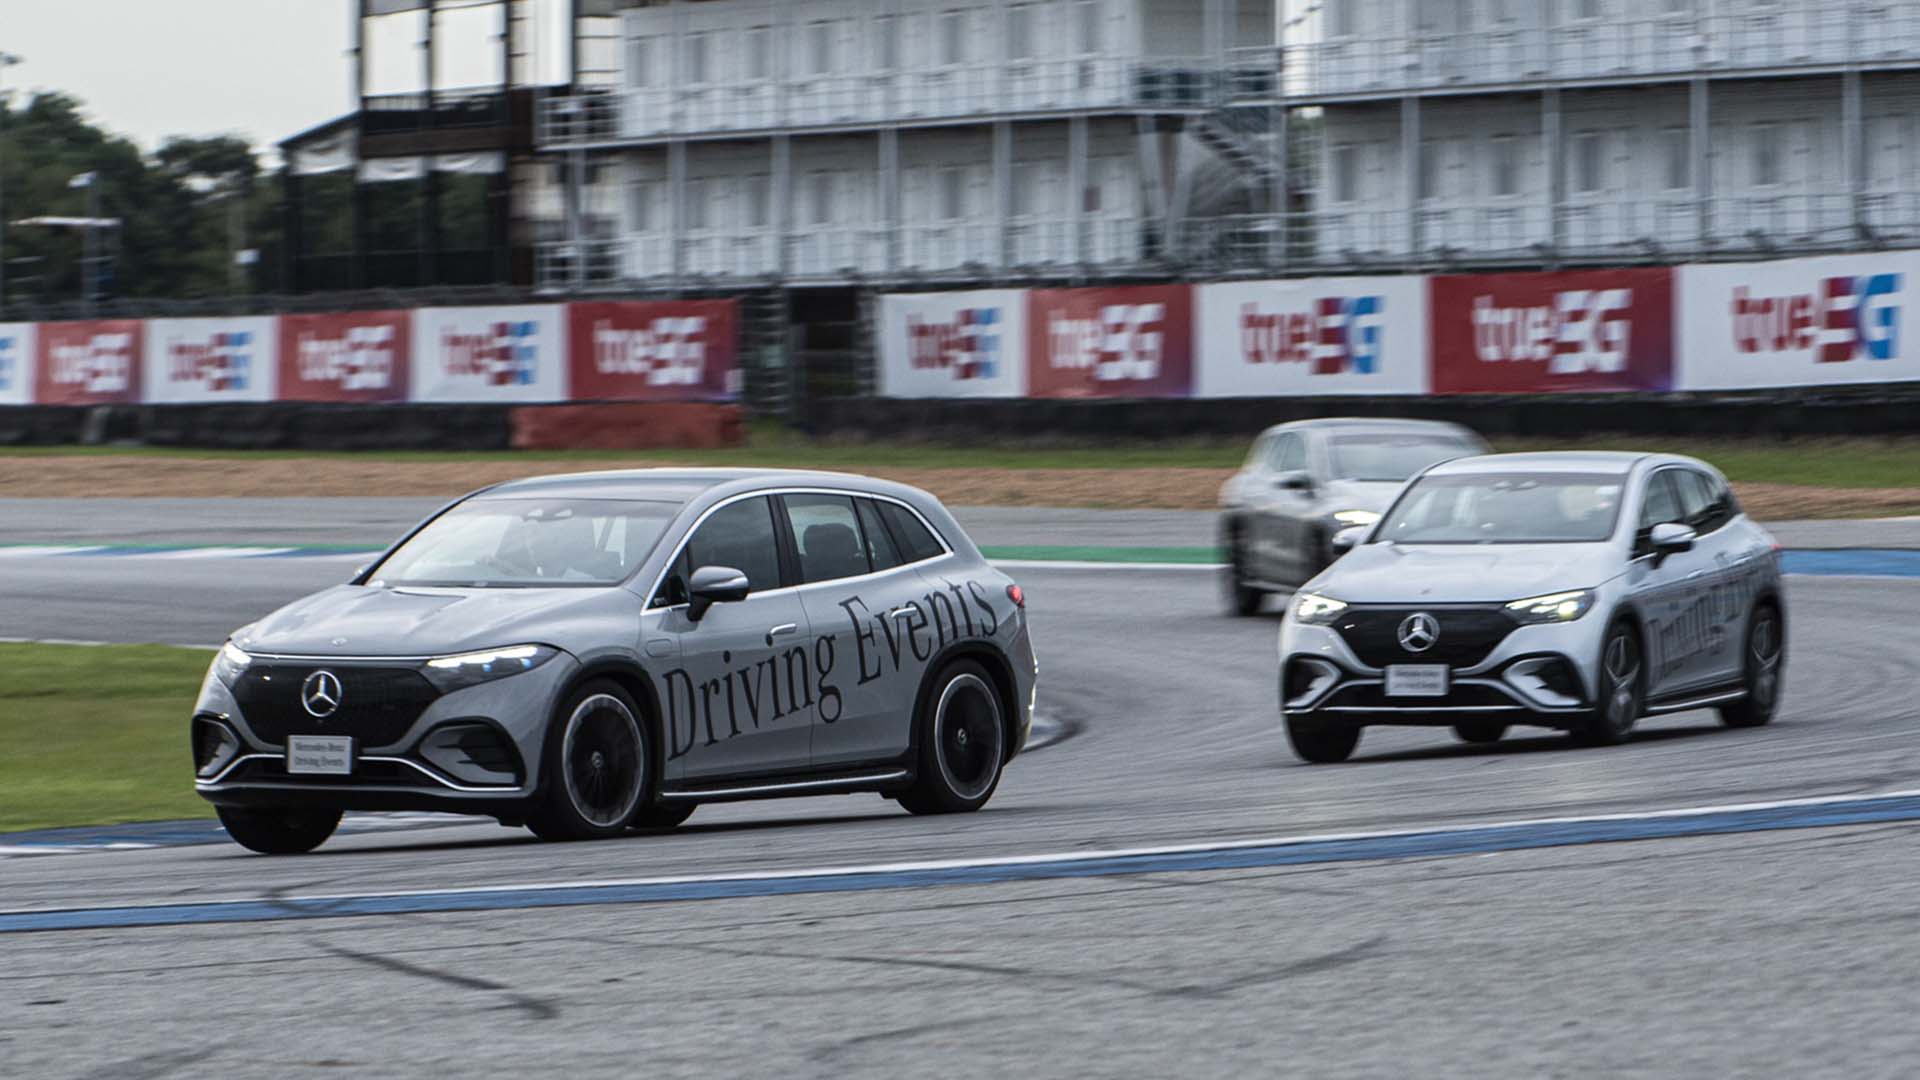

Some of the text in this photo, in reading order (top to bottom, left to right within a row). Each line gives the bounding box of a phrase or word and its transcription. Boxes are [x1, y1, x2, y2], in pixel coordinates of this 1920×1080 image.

[1472, 288, 1632, 373] true5G
[1732, 273, 1904, 363] true5G
[662, 578, 998, 761] Driving Events
